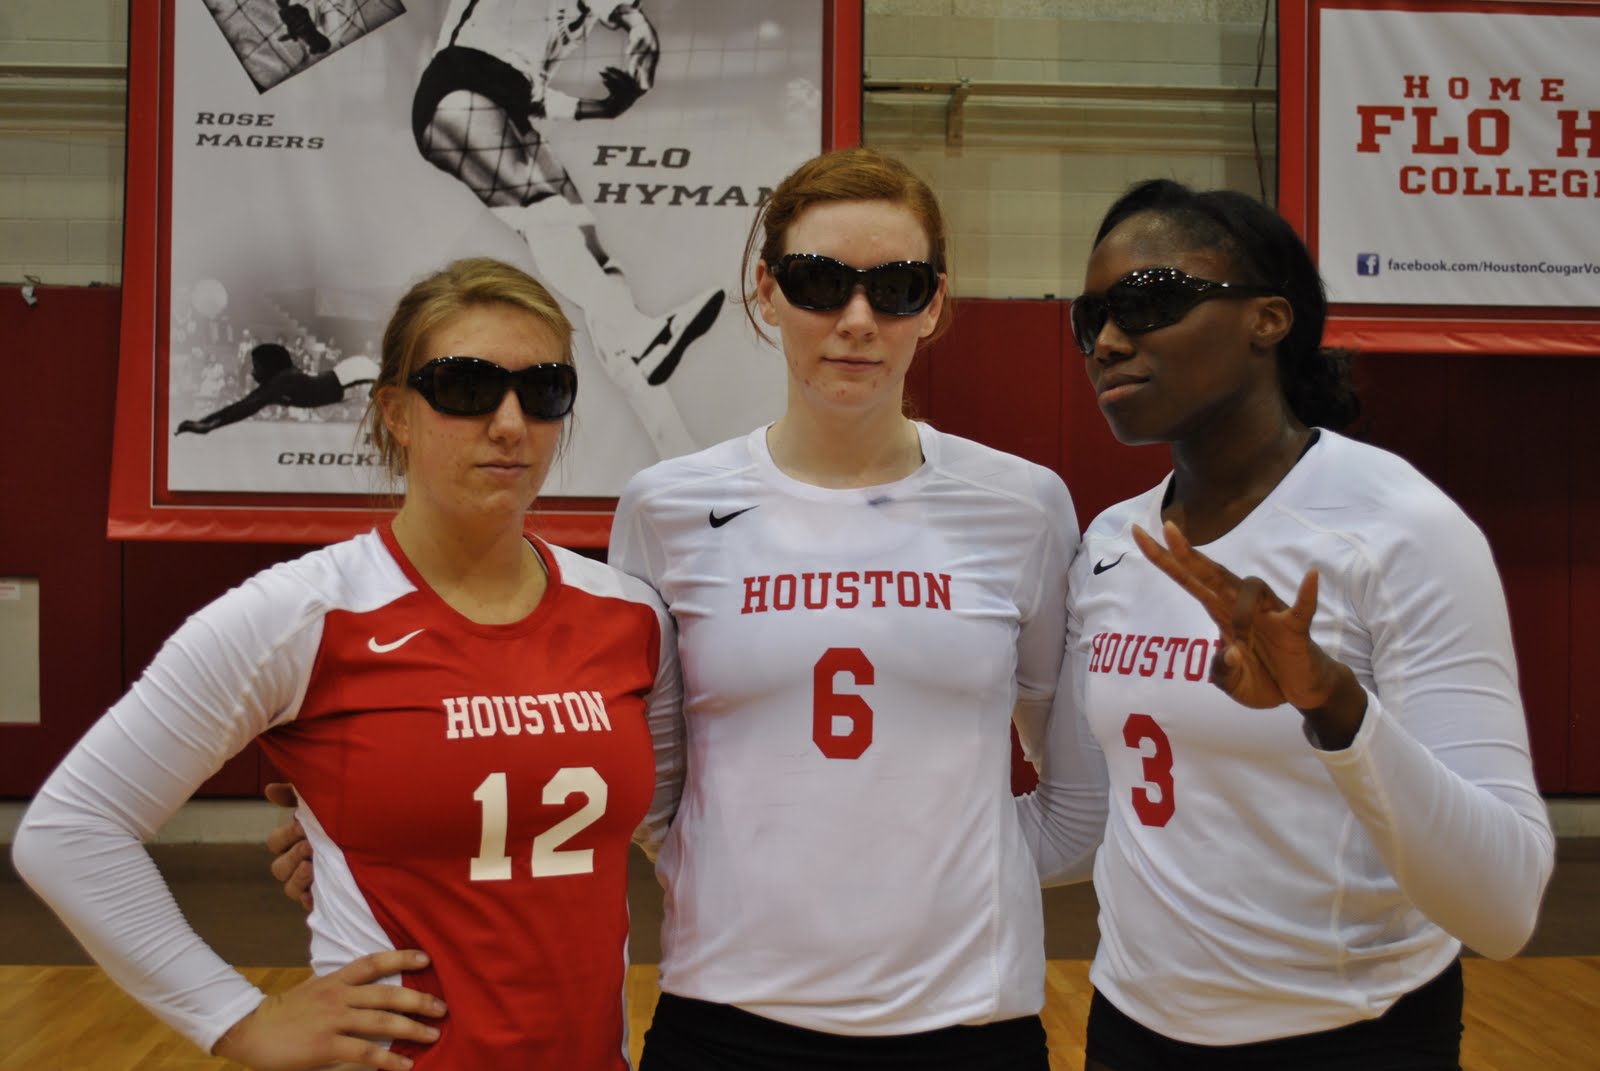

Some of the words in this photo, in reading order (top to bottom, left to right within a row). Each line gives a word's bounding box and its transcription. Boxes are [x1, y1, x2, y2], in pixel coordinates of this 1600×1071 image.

[1403, 75, 1565, 102] HOME
[195, 112, 275, 127] ROSE
[195, 133, 326, 150] MAGERS
[1356, 105, 1510, 156] FLO
[592, 145, 691, 169] FLO
[1399, 165, 1600, 198] COLLEG
[740, 570, 953, 615] HOUSTON
[1088, 631, 1222, 684] HOUSTO
[442, 690, 612, 740] HOUSTON
[812, 647, 875, 760] 6
[1122, 713, 1176, 828] 3
[469, 766, 609, 881] 12
